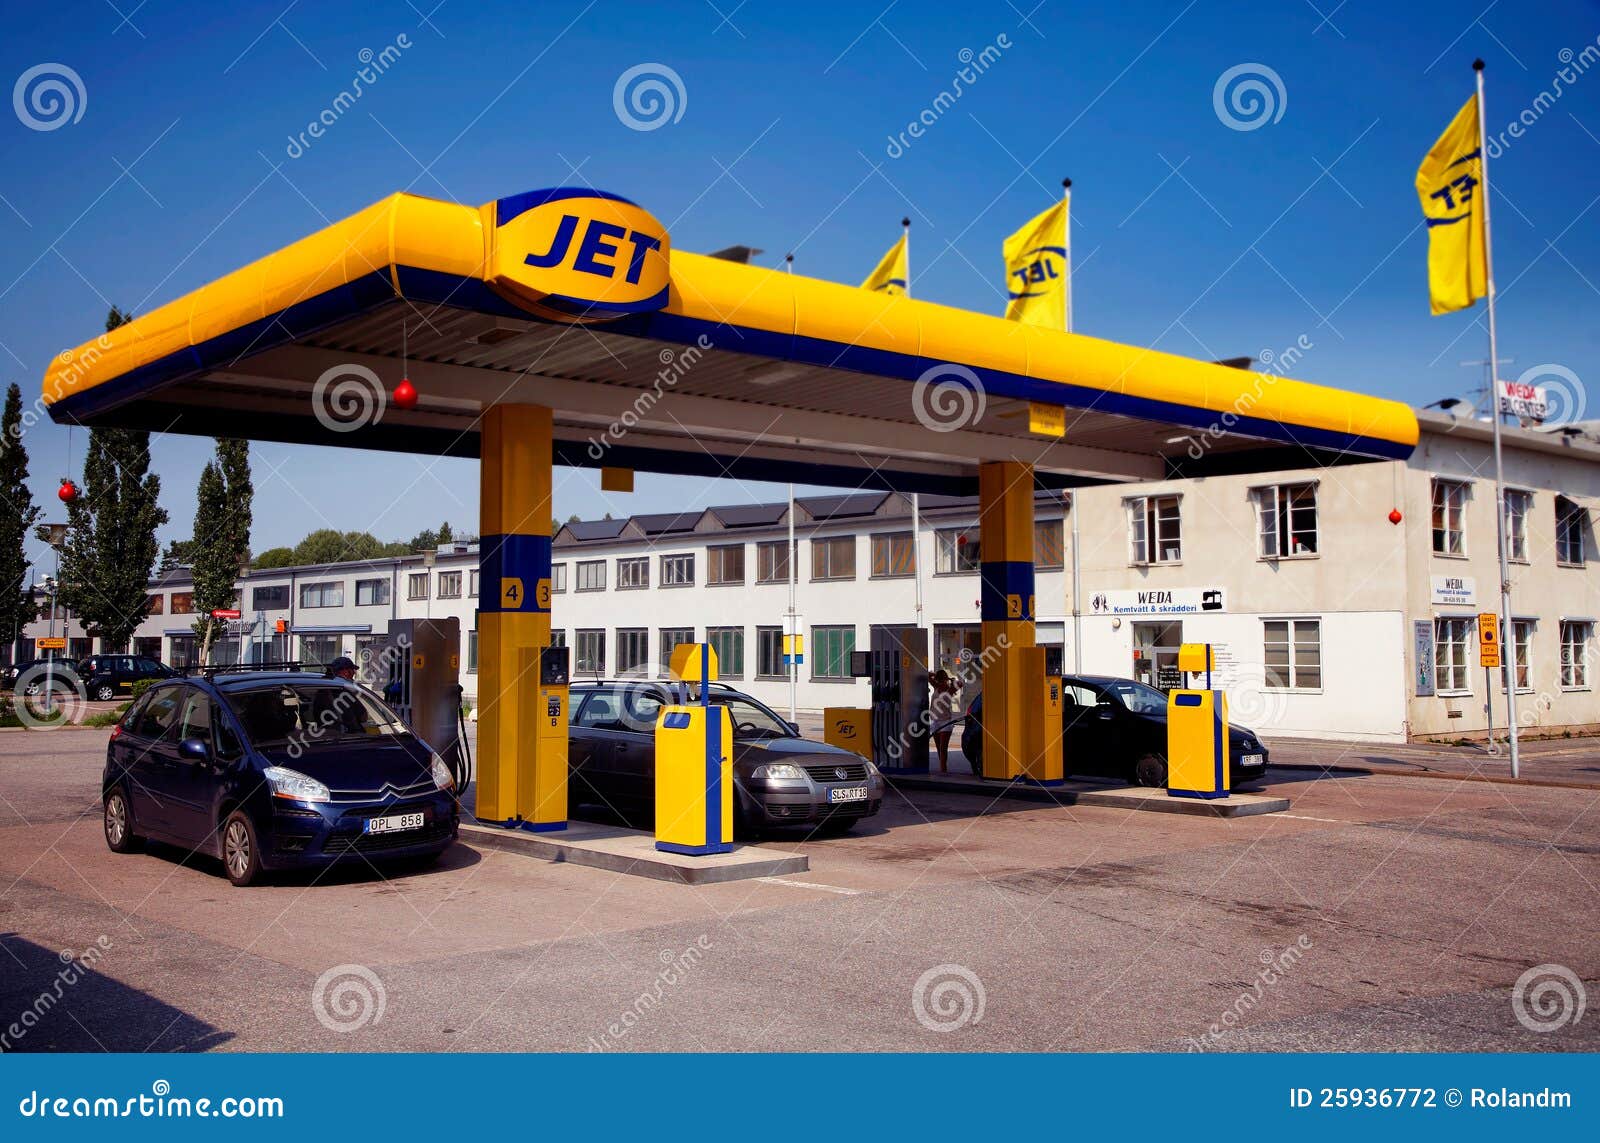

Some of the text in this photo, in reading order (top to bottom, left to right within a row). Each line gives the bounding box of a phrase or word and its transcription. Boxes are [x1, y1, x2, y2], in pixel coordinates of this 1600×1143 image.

[524, 214, 661, 285] JET
[1505, 382, 1537, 400] WEDA
[1445, 578, 1463, 589] WEDA
[506, 585, 518, 601] 4
[541, 586, 549, 602] 3
[1137, 591, 1172, 604] WEDA
[1012, 600, 1018, 613] 2
[551, 718, 557, 727] B
[838, 725, 855, 735] JET
[832, 790, 846, 800] SLS
[371, 814, 422, 830] OPL 858
